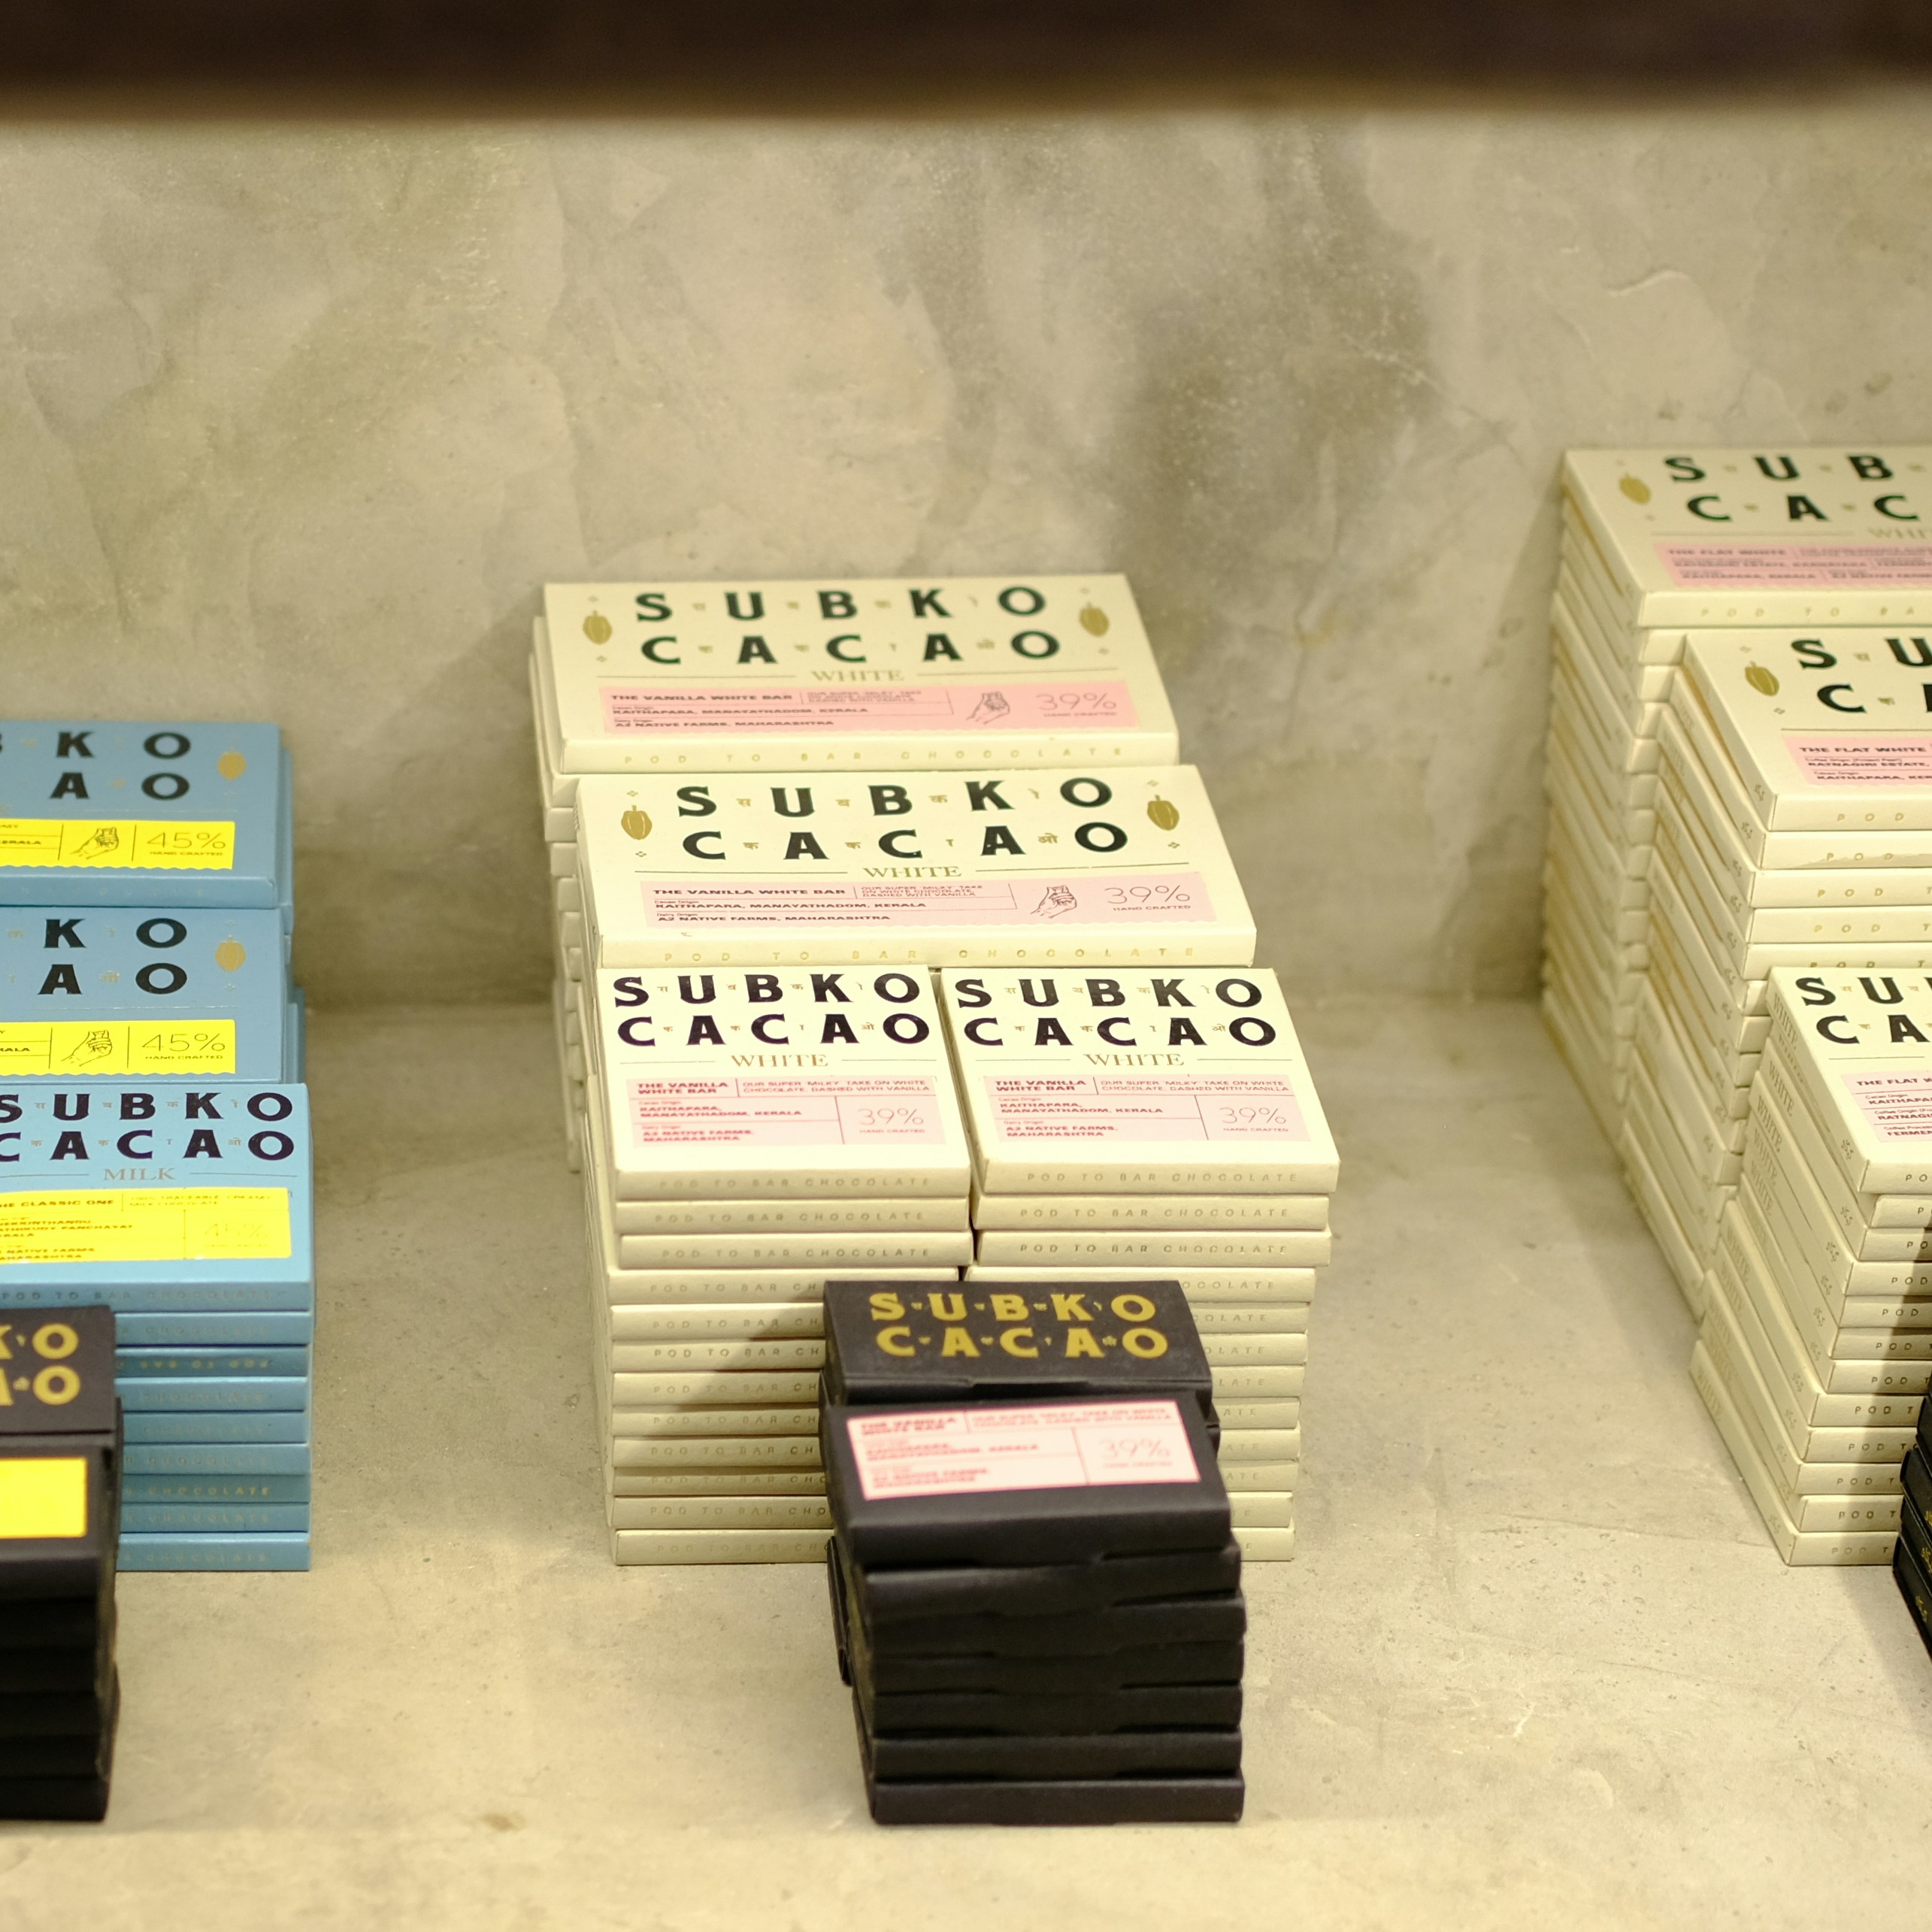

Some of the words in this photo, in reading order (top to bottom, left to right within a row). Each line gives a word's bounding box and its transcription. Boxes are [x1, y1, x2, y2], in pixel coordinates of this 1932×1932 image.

[1664, 455, 1894, 482] SUB
[1687, 494, 1920, 521] CAC
[635, 586, 1046, 622] SUBKO
[641, 630, 1060, 665] CACAO
[811, 669, 905, 683] WHITE
[1038, 693, 1117, 712] 39%
[625, 756, 687, 764] POD
[727, 754, 761, 762] TO
[801, 753, 861, 761] BAR
[901, 748, 1121, 759] CHOCOLATE
[677, 777, 1112, 817] SUBKO
[1837, 813, 1903, 821] POD
[147, 832, 226, 849] 45%
[682, 822, 1128, 860] CACAO
[1827, 852, 1893, 861] POD
[863, 866, 962, 878] WHITE
[1105, 886, 1190, 904] 39%
[1818, 888, 1883, 897] POD
[665, 953, 730, 961] POD
[773, 952, 809, 960] TO
[958, 948, 1192, 958] CHOCOLATE
[613, 973, 919, 1007] SUBKO
[955, 979, 1261, 1007] SUBKO
[617, 1013, 930, 1046] CACAO
[1774, 993, 1797, 1050] WHITE.
[964, 1017, 1276, 1046] CACAO
[142, 1033, 225, 1052] 45%
[731, 1054, 828, 1067] WHITE
[1083, 1054, 1184, 1066] WHITE
[1769, 1060, 1794, 1117] WHITE.
[0, 1092, 292, 1122] SUBKO
[1220, 1108, 1286, 1125] 39%
[858, 1108, 923, 1126] 39%
[1758, 1095, 1782, 1153] WHITE.
[0, 1129, 294, 1161] CACAO
[104, 1167, 175, 1181] MILK
[1027, 1173, 1065, 1182] POD
[1081, 1173, 1104, 1182] TO
[1120, 1173, 1155, 1182] BAR
[1171, 1173, 1298, 1182] CHOCOLATE
[1020, 1209, 1058, 1218] POD
[1074, 1209, 1095, 1218] TO
[1112, 1209, 1148, 1218] BAR
[1164, 1209, 1289, 1218] CHOCOLATE
[1020, 1244, 1058, 1253] POD
[1074, 1244, 1096, 1253] TO
[1110, 1244, 1148, 1253] BAR
[1164, 1244, 1286, 1253] CHOCOLATE
[869, 1293, 1155, 1322] SUBKO
[877, 1326, 1168, 1358] CACAO
[655, 1349, 692, 1358] POD
[708, 1349, 729, 1357] TO
[746, 1349, 780, 1357] BAR
[1099, 1437, 1170, 1458] 39%
